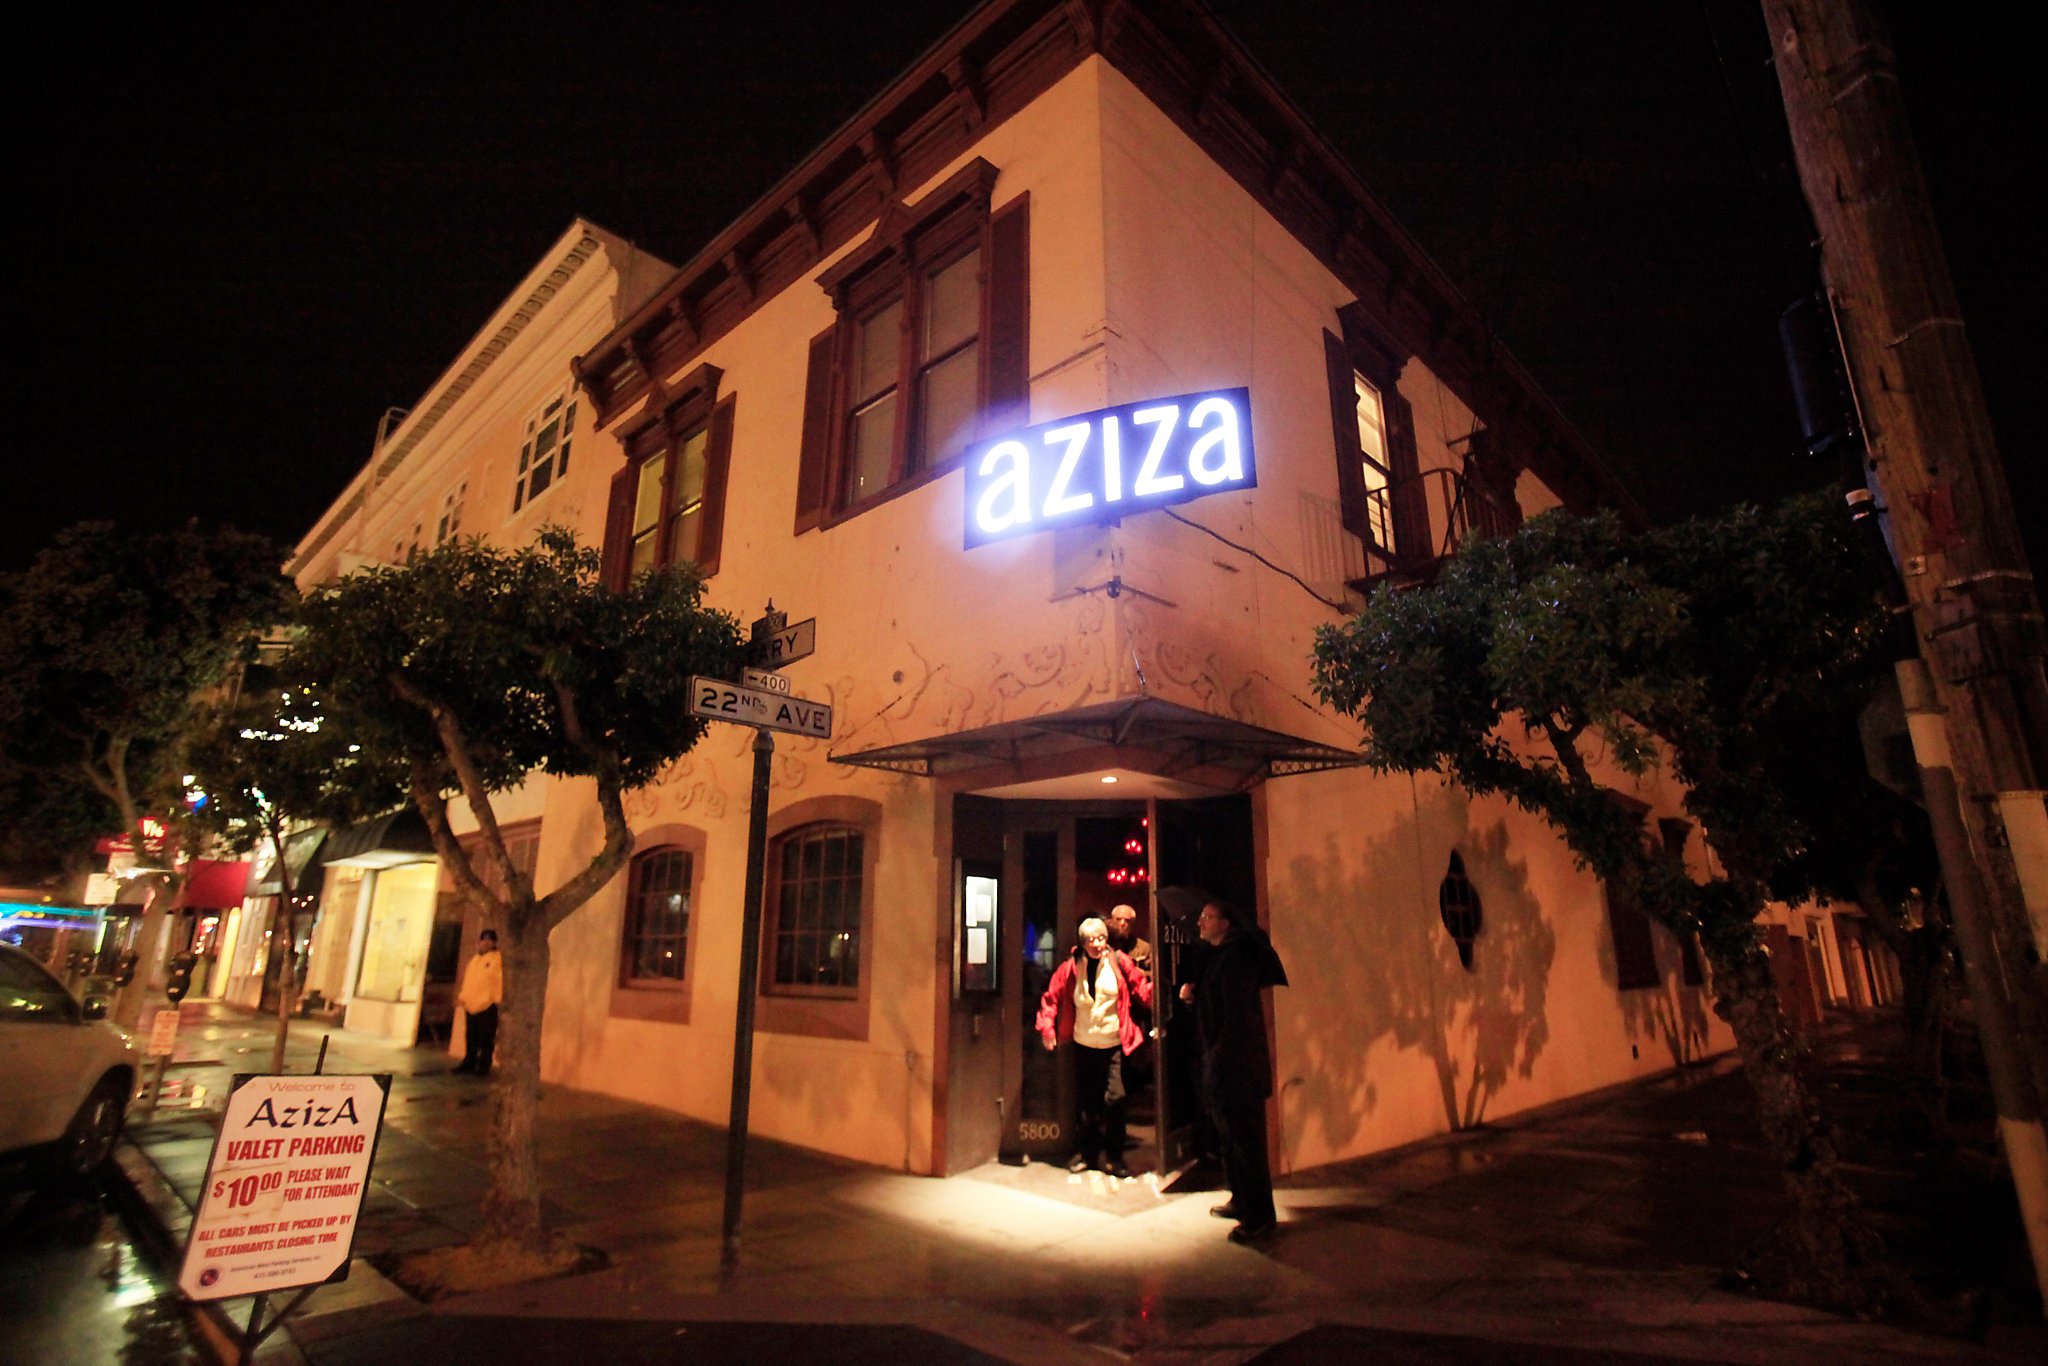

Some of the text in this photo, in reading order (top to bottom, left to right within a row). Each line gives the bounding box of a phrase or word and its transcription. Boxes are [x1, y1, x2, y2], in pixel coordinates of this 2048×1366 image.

[976, 397, 1244, 533] aziza
[775, 703, 825, 731] AVE
[269, 1080, 356, 1092] Welcome to
[244, 1096, 360, 1129] AzizA
[1020, 1122, 1060, 1140] 5800
[227, 1134, 366, 1161] VALET PARKING
[287, 1166, 351, 1184] PLEASE WAIT
[284, 1183, 360, 1202] FOR ATTENDANT
[198, 1214, 352, 1241] ALL CARS MUST BE PICKED UP BY
[205, 1232, 339, 1258] RESTAURANTS CLOSING TIME
